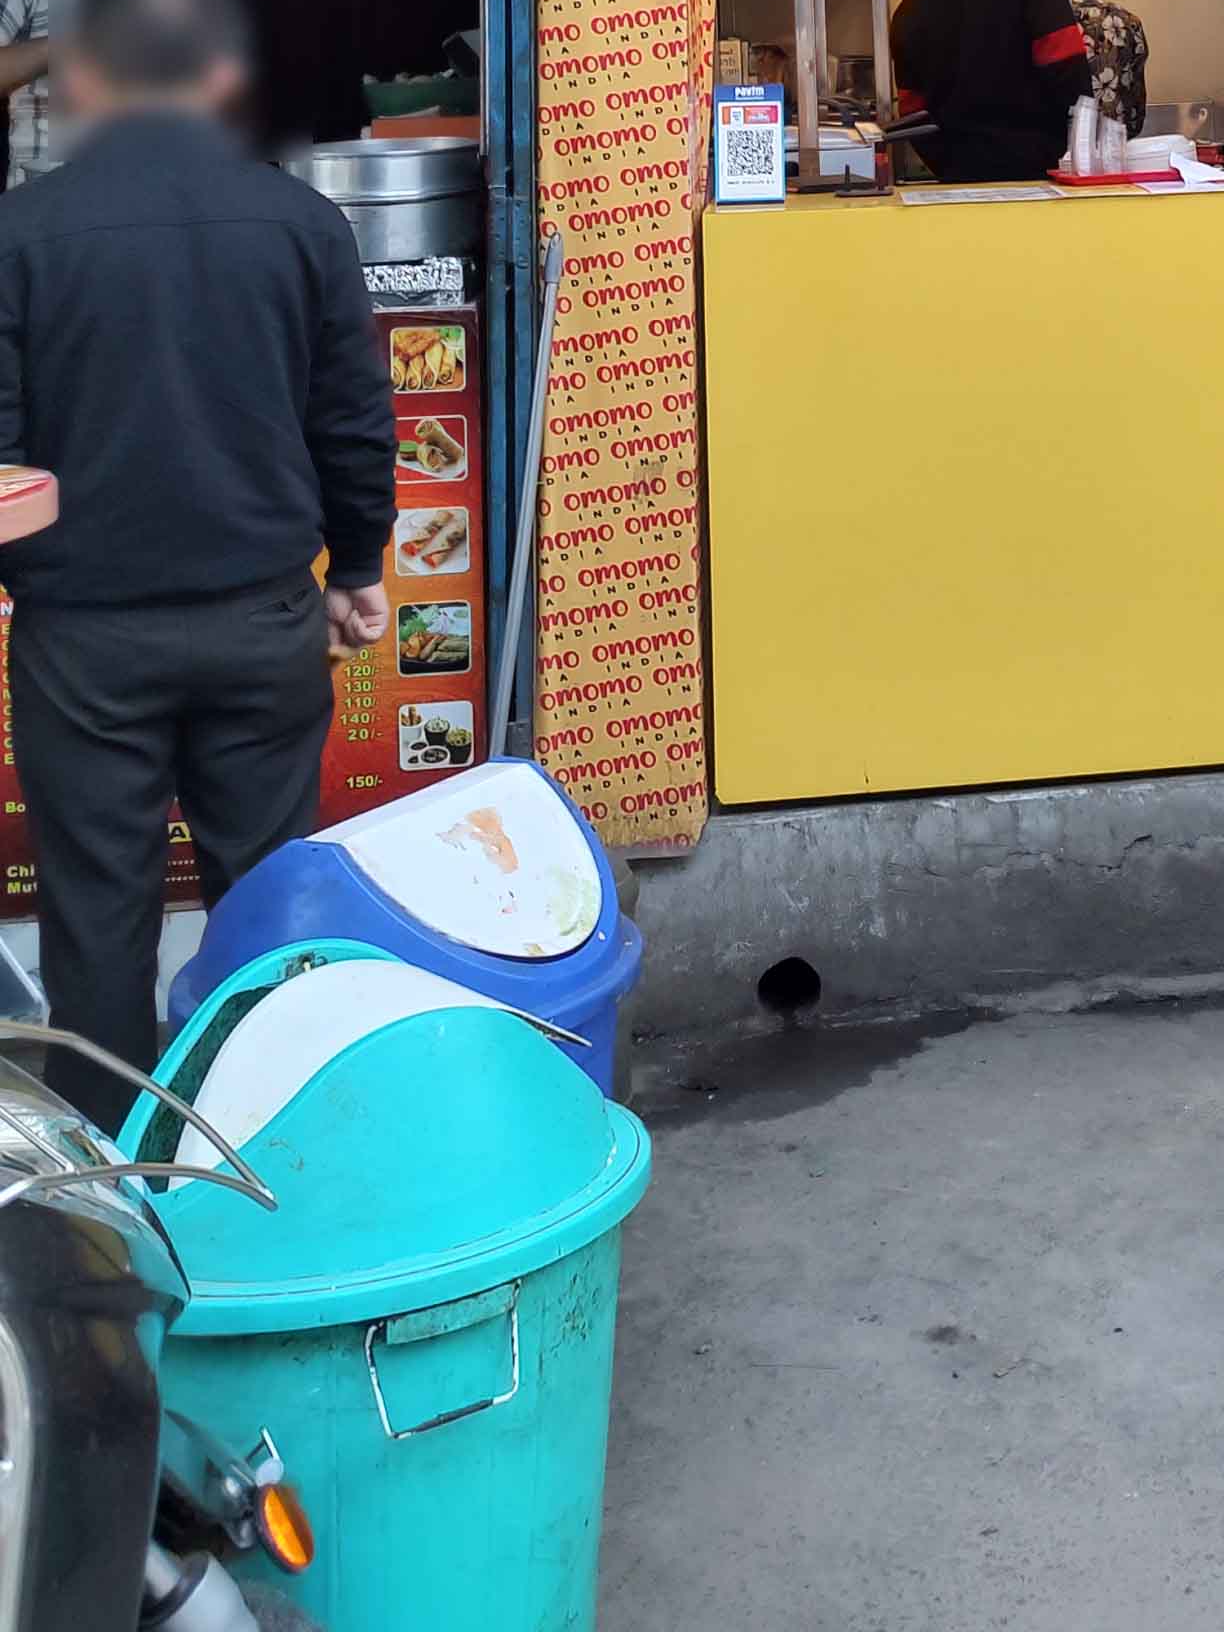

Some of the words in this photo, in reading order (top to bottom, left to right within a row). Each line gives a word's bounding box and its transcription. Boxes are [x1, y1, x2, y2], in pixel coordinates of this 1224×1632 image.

[554, 72, 630, 90] INDIA
[583, 223, 659, 242] INDIA
[565, 425, 640, 445] INDIA
[593, 576, 669, 596] INDIA
[607, 652, 683, 672] INDIA
[554, 699, 630, 720] INDIA
